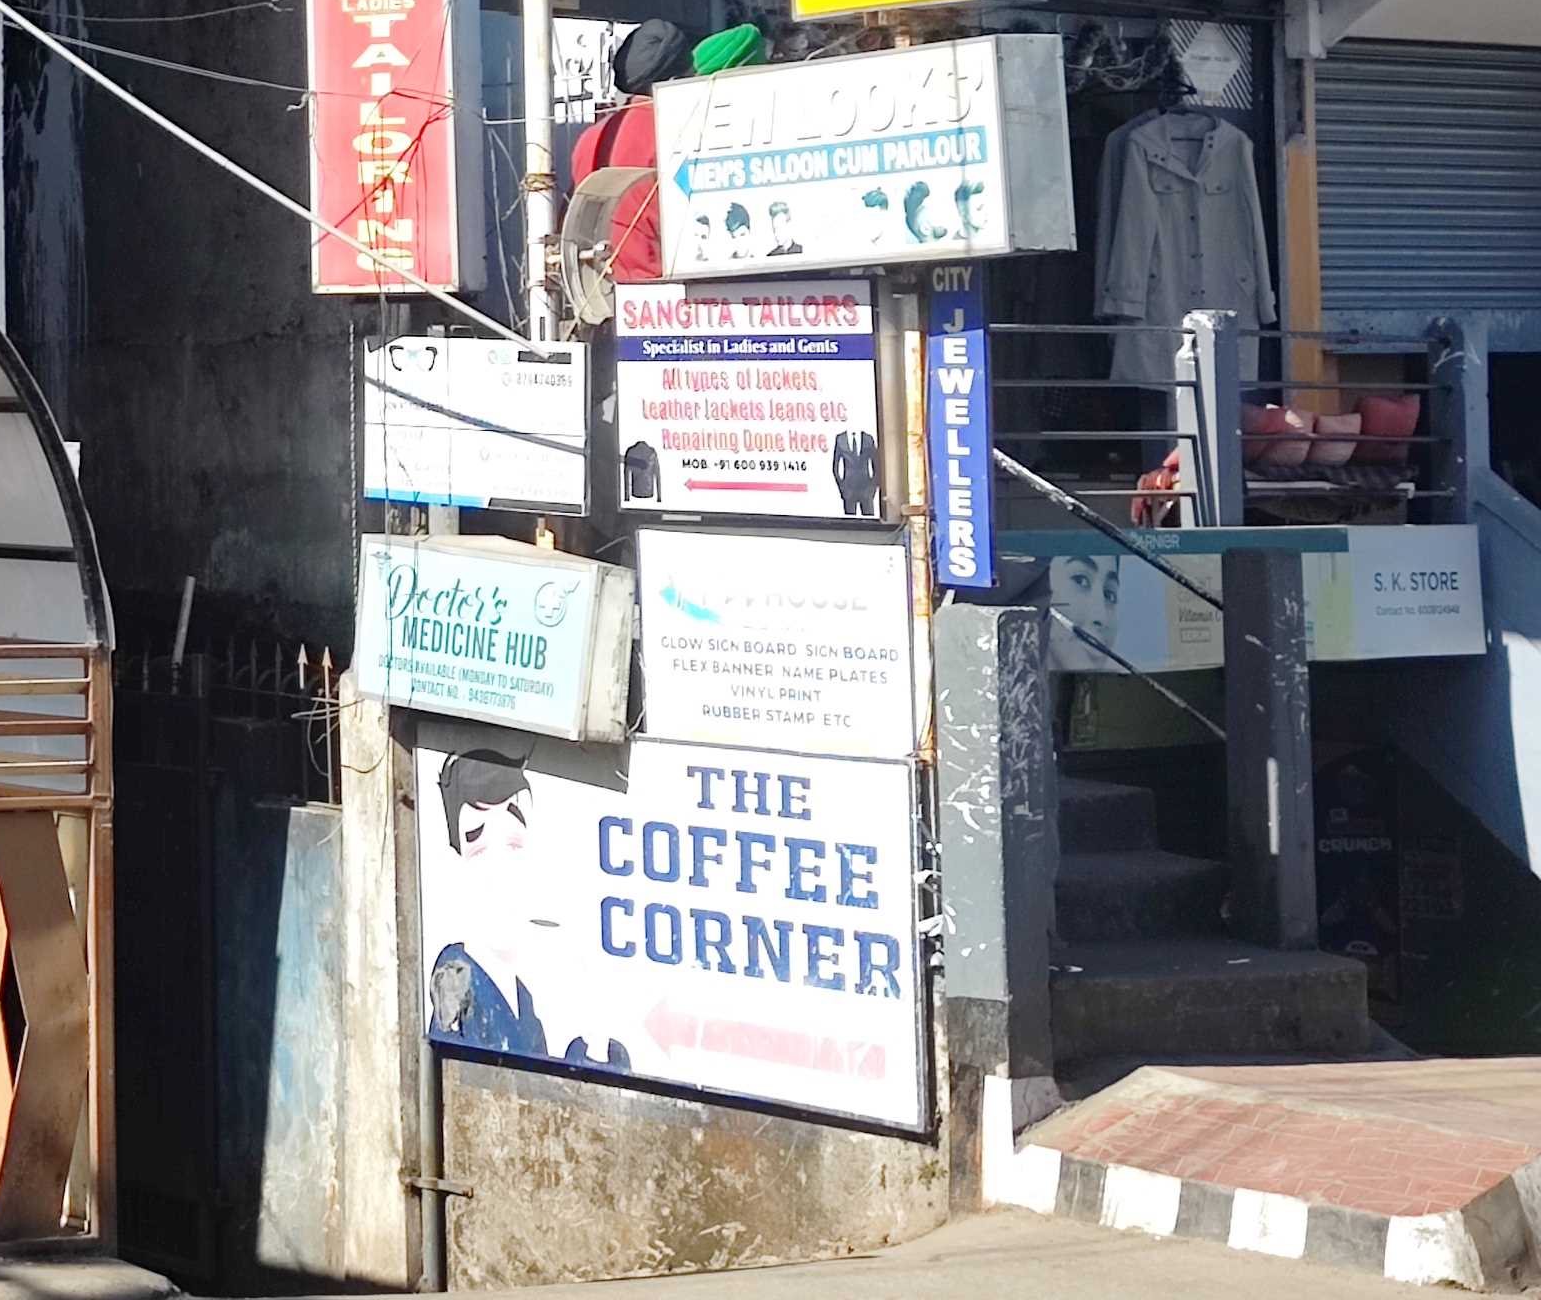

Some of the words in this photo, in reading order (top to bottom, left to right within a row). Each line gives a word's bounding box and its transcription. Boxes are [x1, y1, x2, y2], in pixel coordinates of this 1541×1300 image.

[751, 148, 828, 184] SALOON
[833, 141, 877, 175] CUM
[884, 131, 983, 170] PARLOUR
[932, 266, 974, 292] CITY
[624, 297, 735, 329] SANGITA
[741, 293, 861, 327] TAILORS
[642, 339, 705, 358] Specialist
[723, 337, 767, 355] Ladies
[769, 337, 795, 355] and
[798, 337, 838, 355] Gents
[661, 428, 738, 455] Repairing
[743, 430, 784, 453] Done
[789, 431, 829, 454] Here
[937, 308, 977, 579] JEWELLERS
[1374, 572, 1387, 592] S.
[1391, 572, 1406, 592] K.
[1410, 571, 1460, 591] STORE
[402, 614, 498, 663] MEDICINE
[505, 630, 548, 671] HUB
[744, 640, 797, 657] BOARD
[843, 645, 898, 662] BOARD
[673, 658, 707, 674] FLEX
[713, 660, 774, 677] BANNER
[782, 666, 824, 681] NAME
[829, 668, 888, 685] PLATES
[731, 684, 774, 700] VINYL
[779, 686, 823, 703] PRINT
[702, 703, 761, 721] RUBBER
[766, 709, 816, 725] STAMP
[823, 713, 853, 728] ETC
[686, 764, 813, 822] THE
[598, 814, 880, 911] COFFEE
[599, 894, 902, 1000] CORNER
